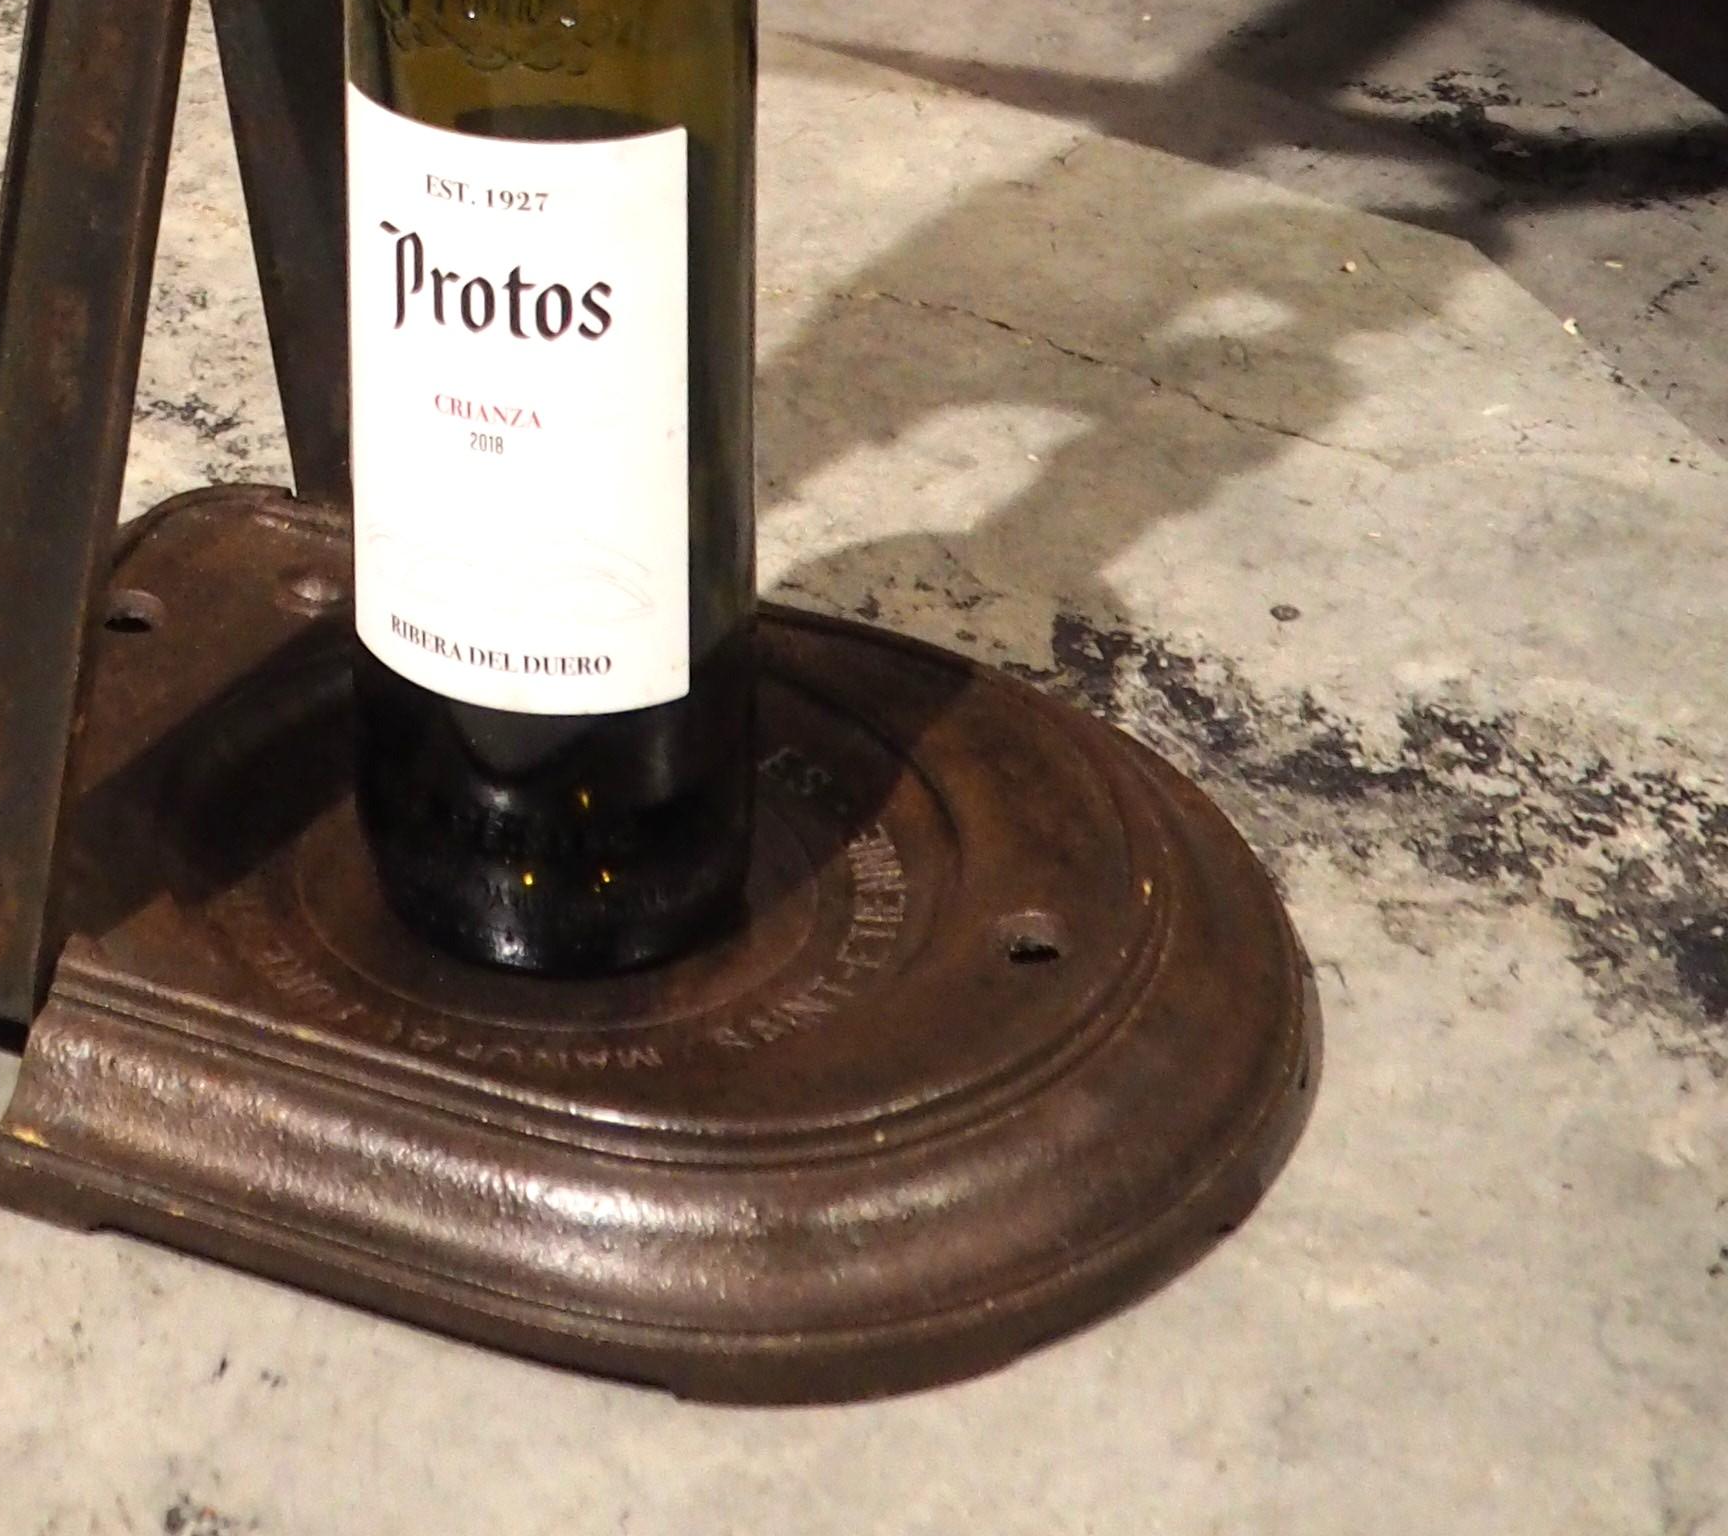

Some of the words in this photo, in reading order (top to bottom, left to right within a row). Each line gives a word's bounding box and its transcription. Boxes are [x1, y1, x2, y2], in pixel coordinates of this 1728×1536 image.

[425, 173, 476, 205] EST.
[485, 188, 549, 213] 1927
[379, 221, 613, 342] Protos
[434, 392, 543, 430] CRIANZA
[469, 431, 504, 455] 2018
[390, 613, 463, 662] RIBERA
[468, 645, 518, 674] DEL
[522, 655, 613, 676] DUERO
